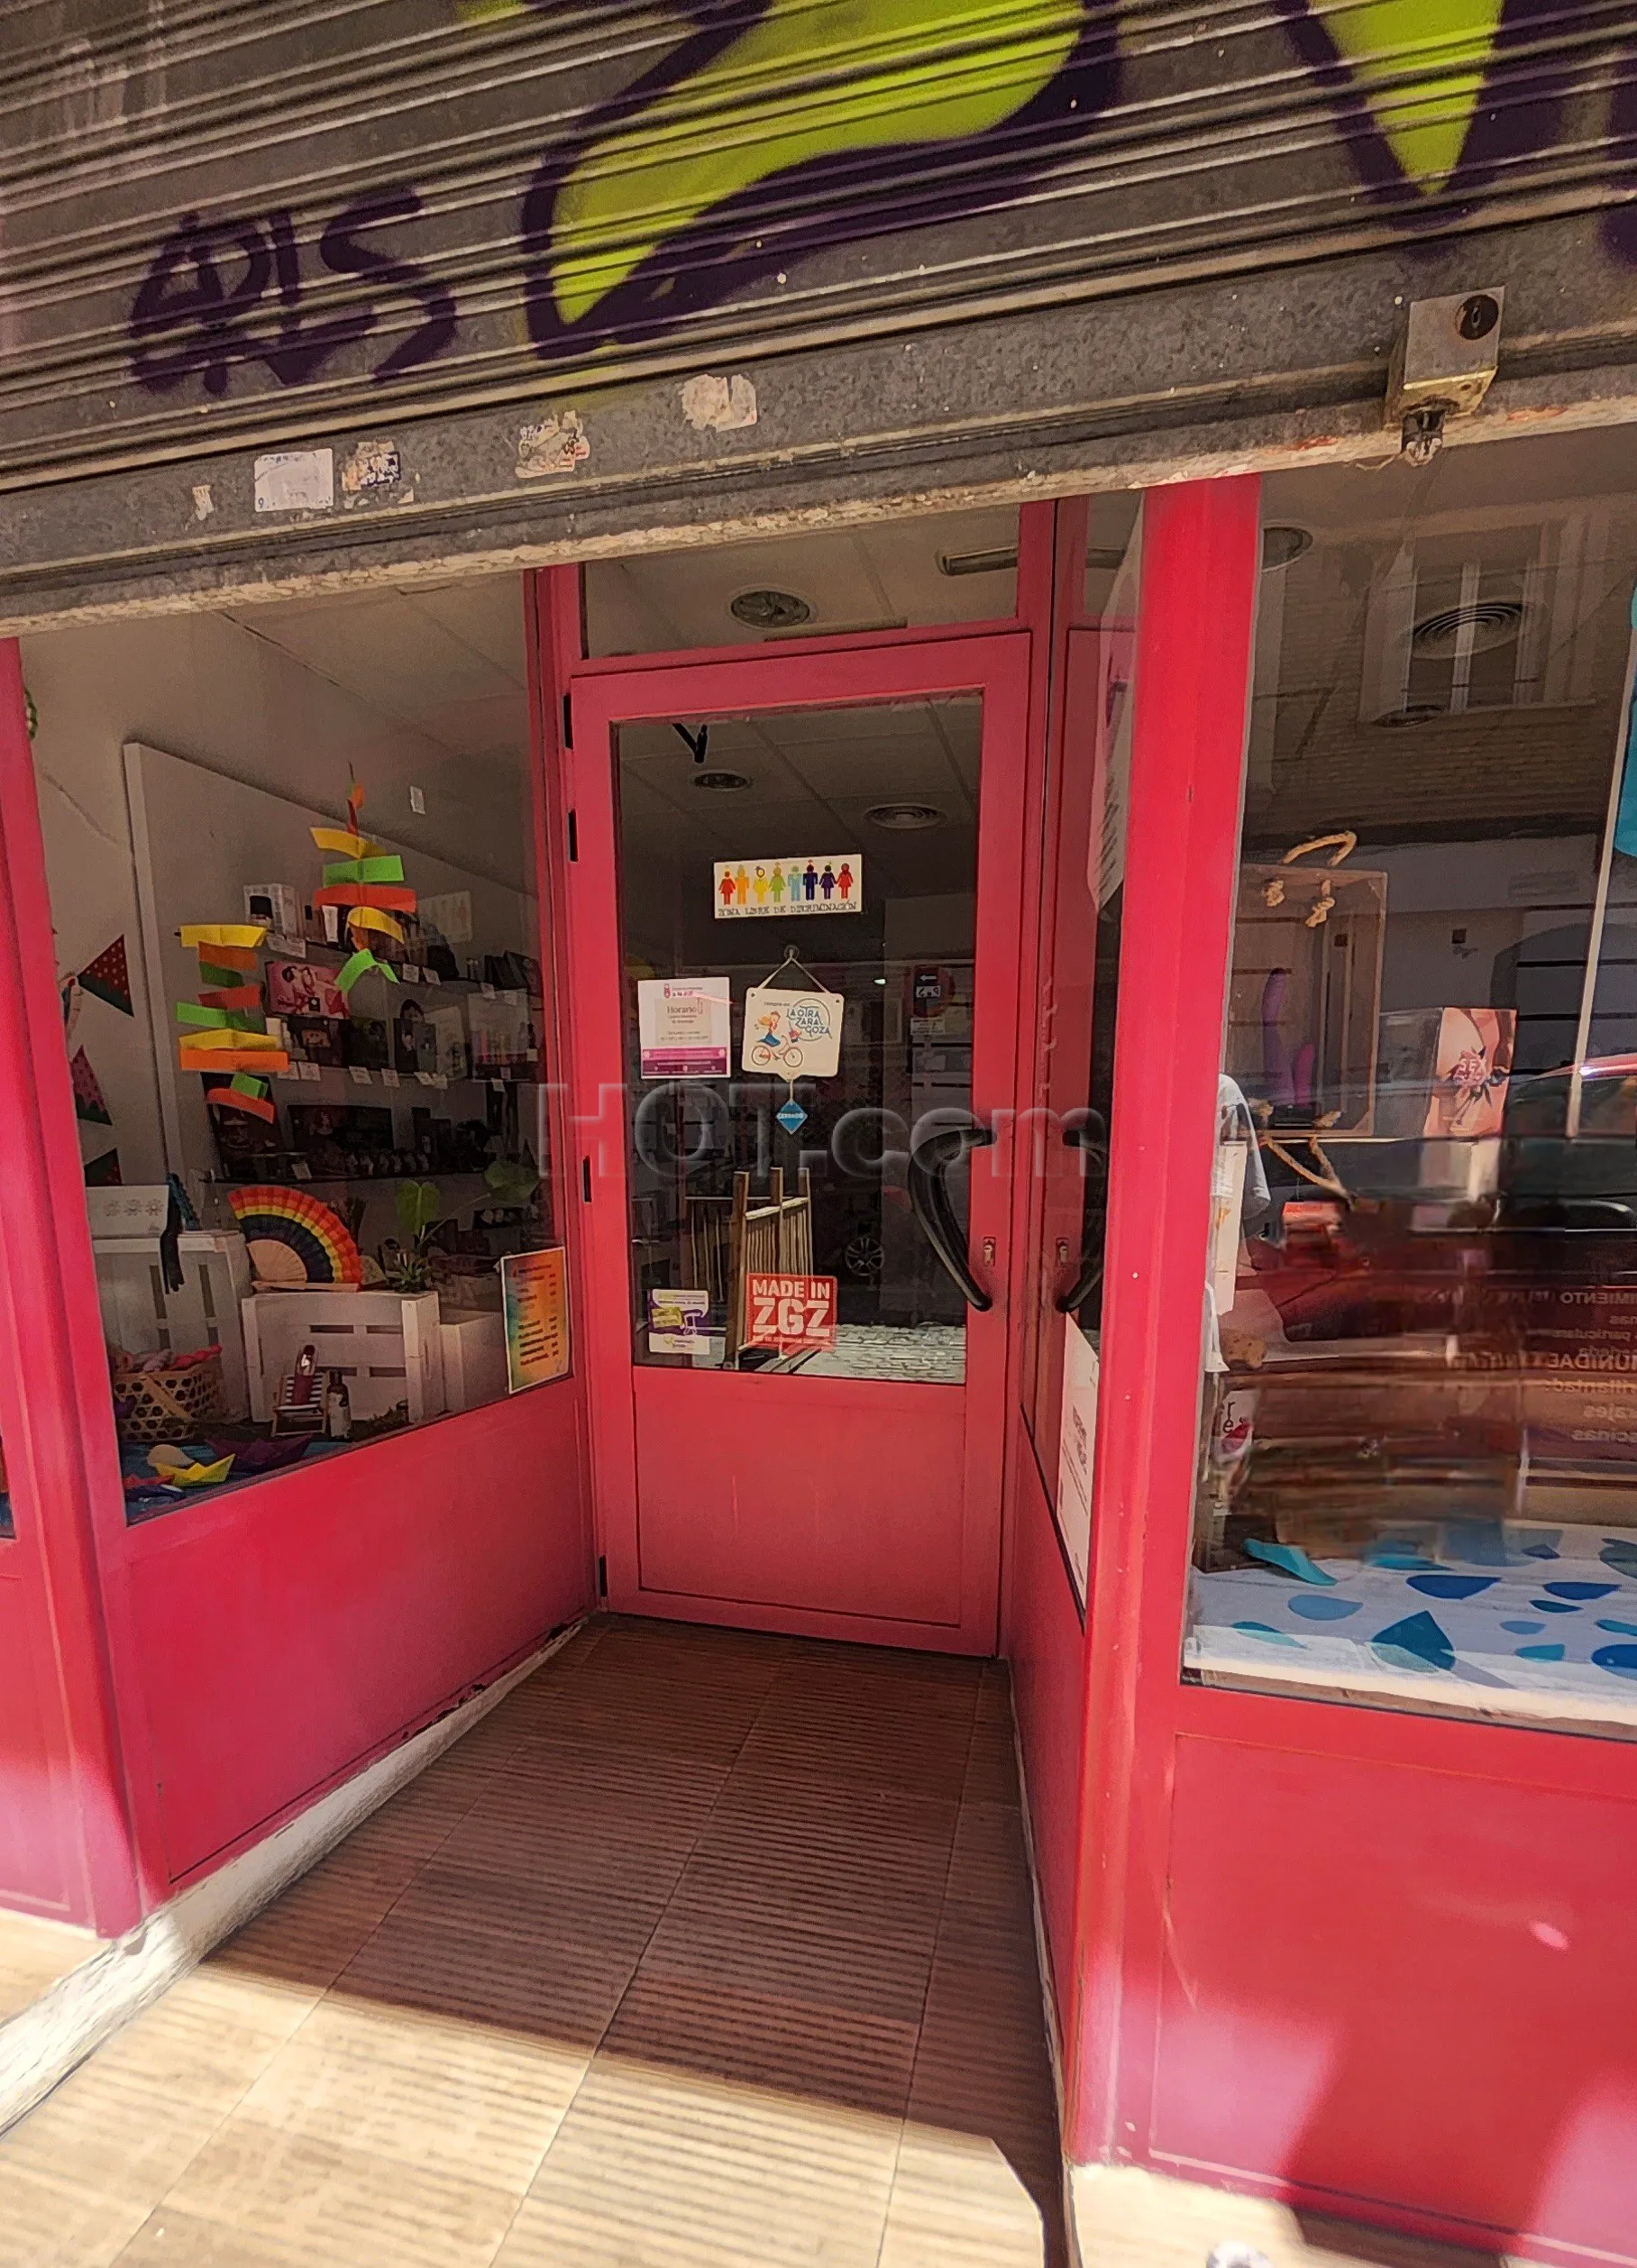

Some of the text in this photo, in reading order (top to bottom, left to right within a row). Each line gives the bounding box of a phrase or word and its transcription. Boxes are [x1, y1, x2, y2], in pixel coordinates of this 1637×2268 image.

[745, 906, 770, 916] LIBRE
[773, 905, 786, 914] DE
[752, 1279, 830, 1299] MADE IN
[752, 1297, 830, 1337] ZGZ
